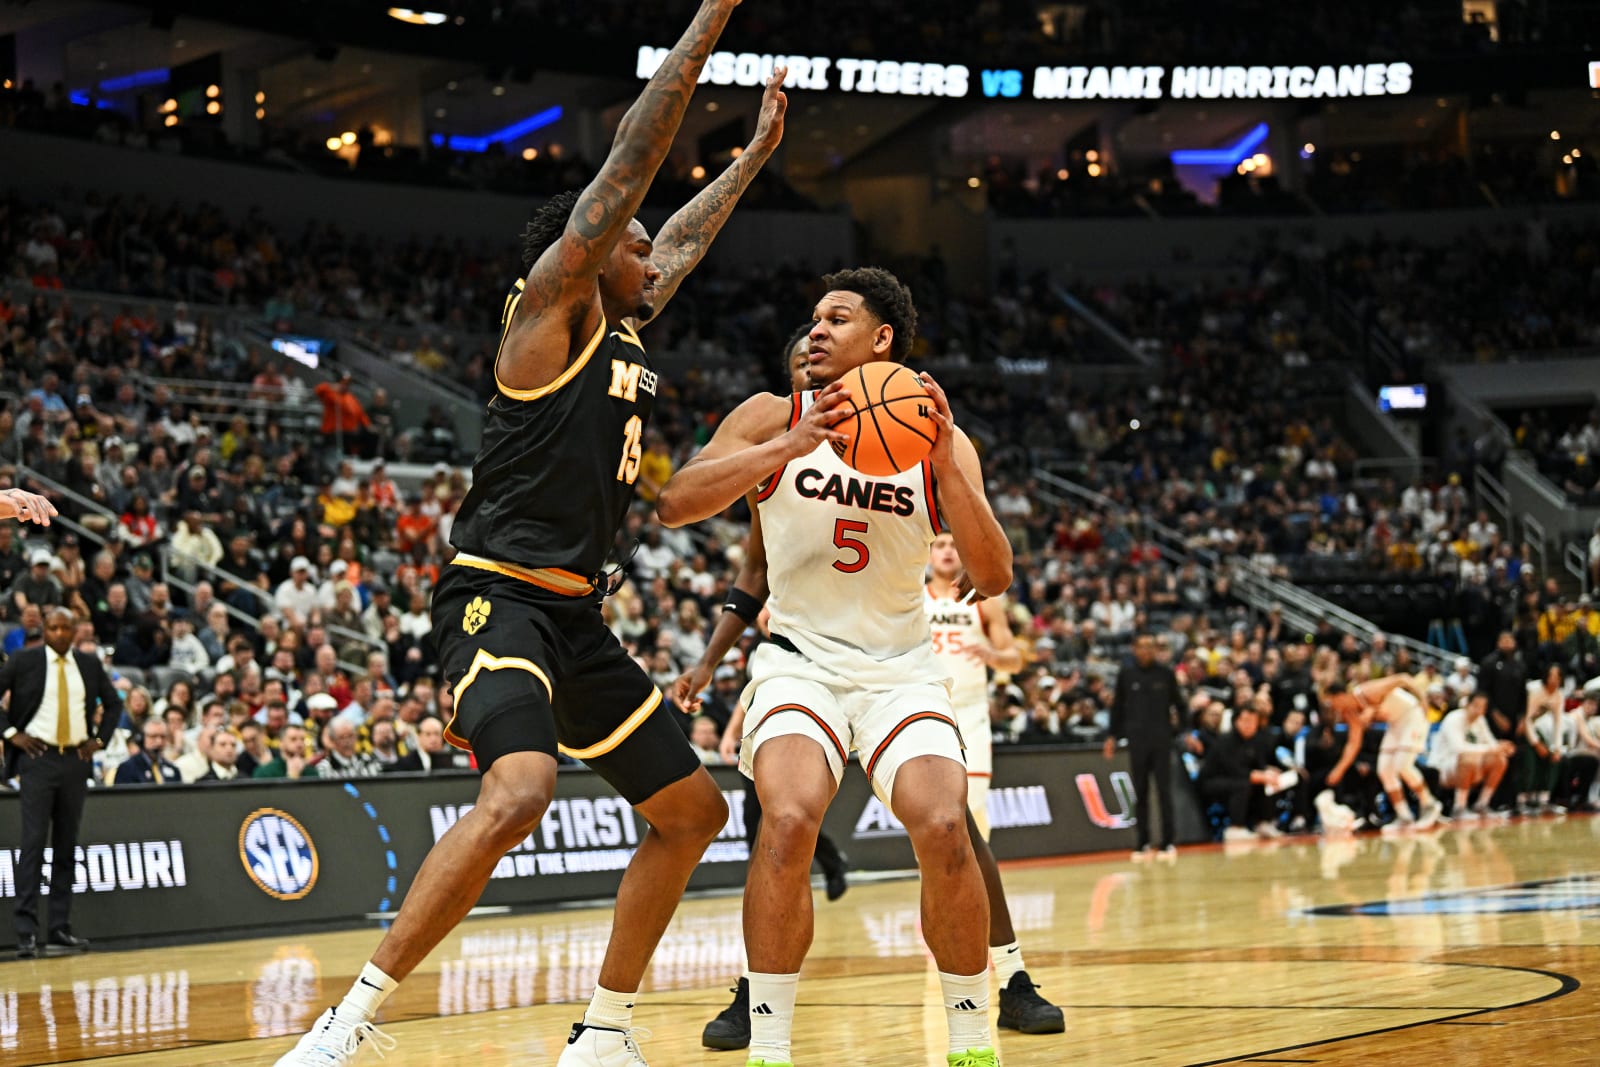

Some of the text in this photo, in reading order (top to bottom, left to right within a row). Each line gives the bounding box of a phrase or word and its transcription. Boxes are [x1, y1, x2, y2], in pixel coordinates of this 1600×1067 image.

[636, 45, 1412, 98] MSOURI TIGERS VS MIAMI HURRICANES
[795, 468, 915, 518] CANES
[832, 518, 870, 574] 5
[928, 613, 973, 627] ANES
[931, 631, 963, 655] 35
[540, 796, 638, 850] FIRST
[0, 840, 187, 898] MSOURI
[243, 814, 314, 895] SEC
